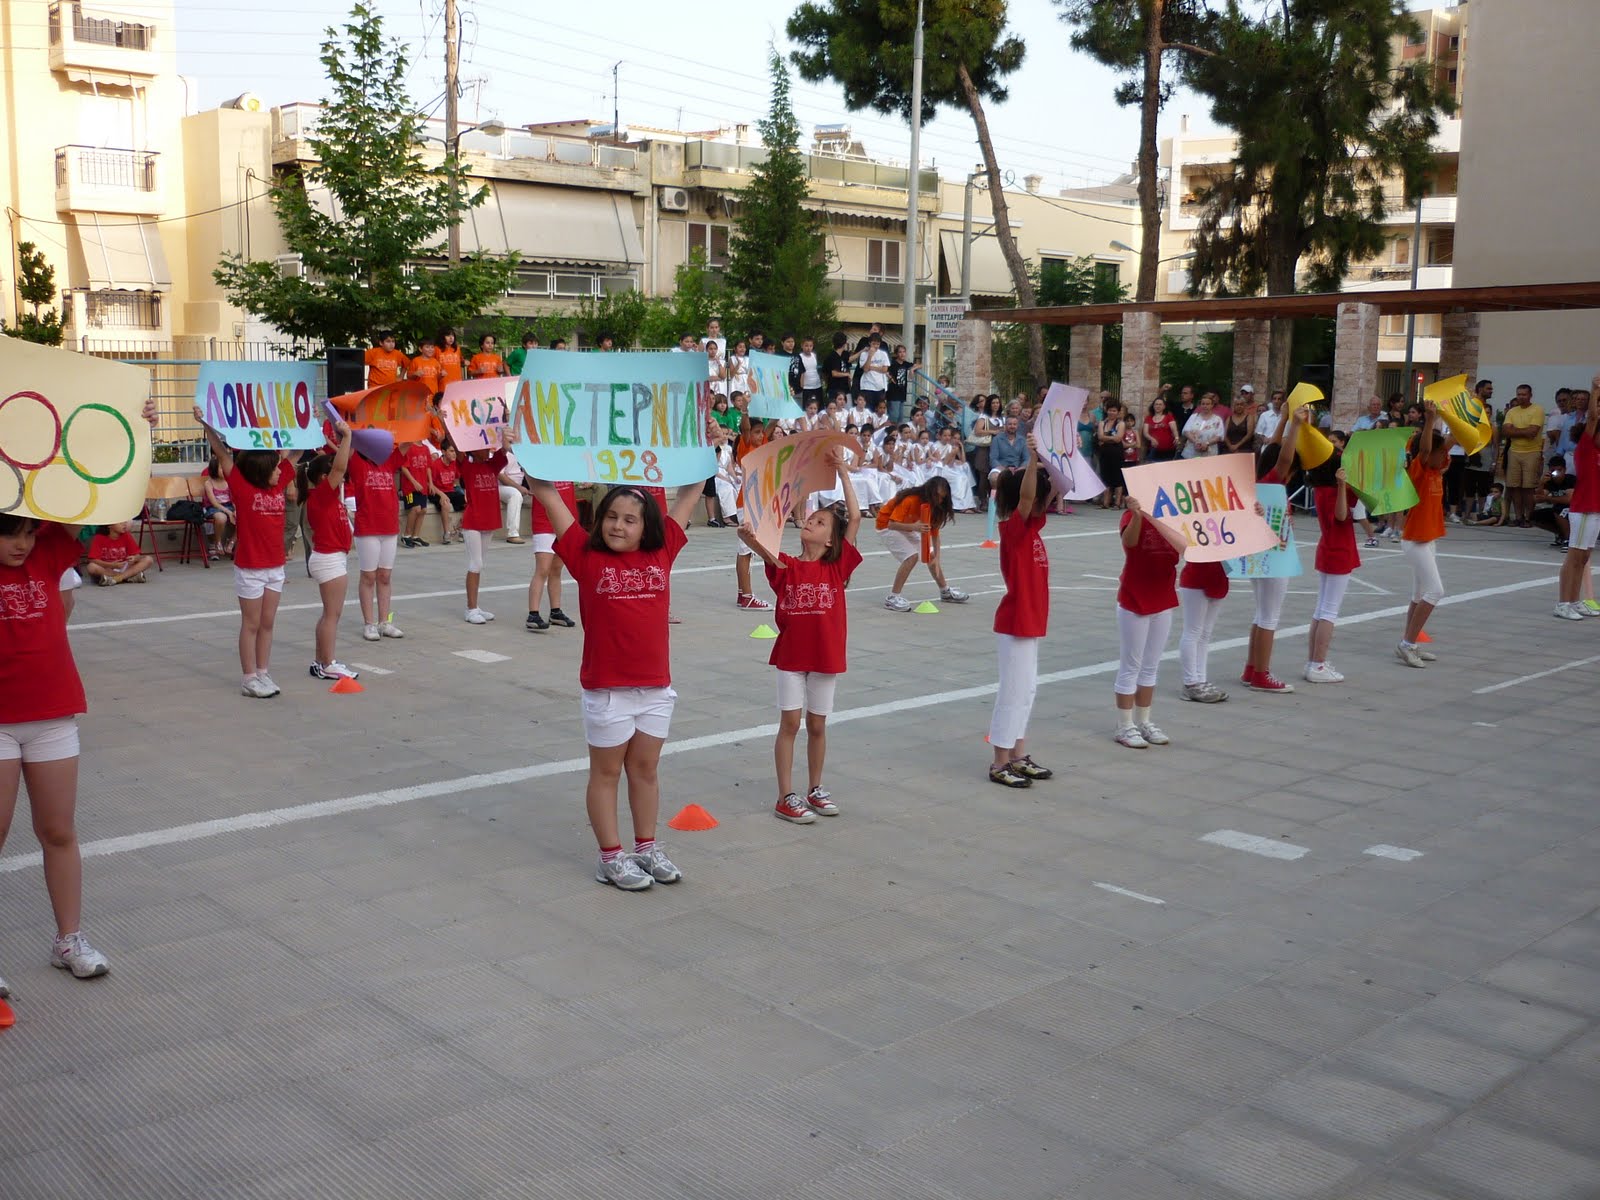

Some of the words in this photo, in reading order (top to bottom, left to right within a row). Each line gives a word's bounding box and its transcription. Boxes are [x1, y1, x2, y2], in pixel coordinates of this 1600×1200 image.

[206, 381, 310, 429] ΛΟΝΔΙΝΟ
[513, 379, 714, 448] ΑΜΣΤΕΡΝΤΑΜ
[248, 430, 294, 448] 2012
[583, 449, 663, 483] 1928
[1152, 475, 1245, 519] ΑΘΗΝΑ
[1180, 516, 1236, 547] 1896
